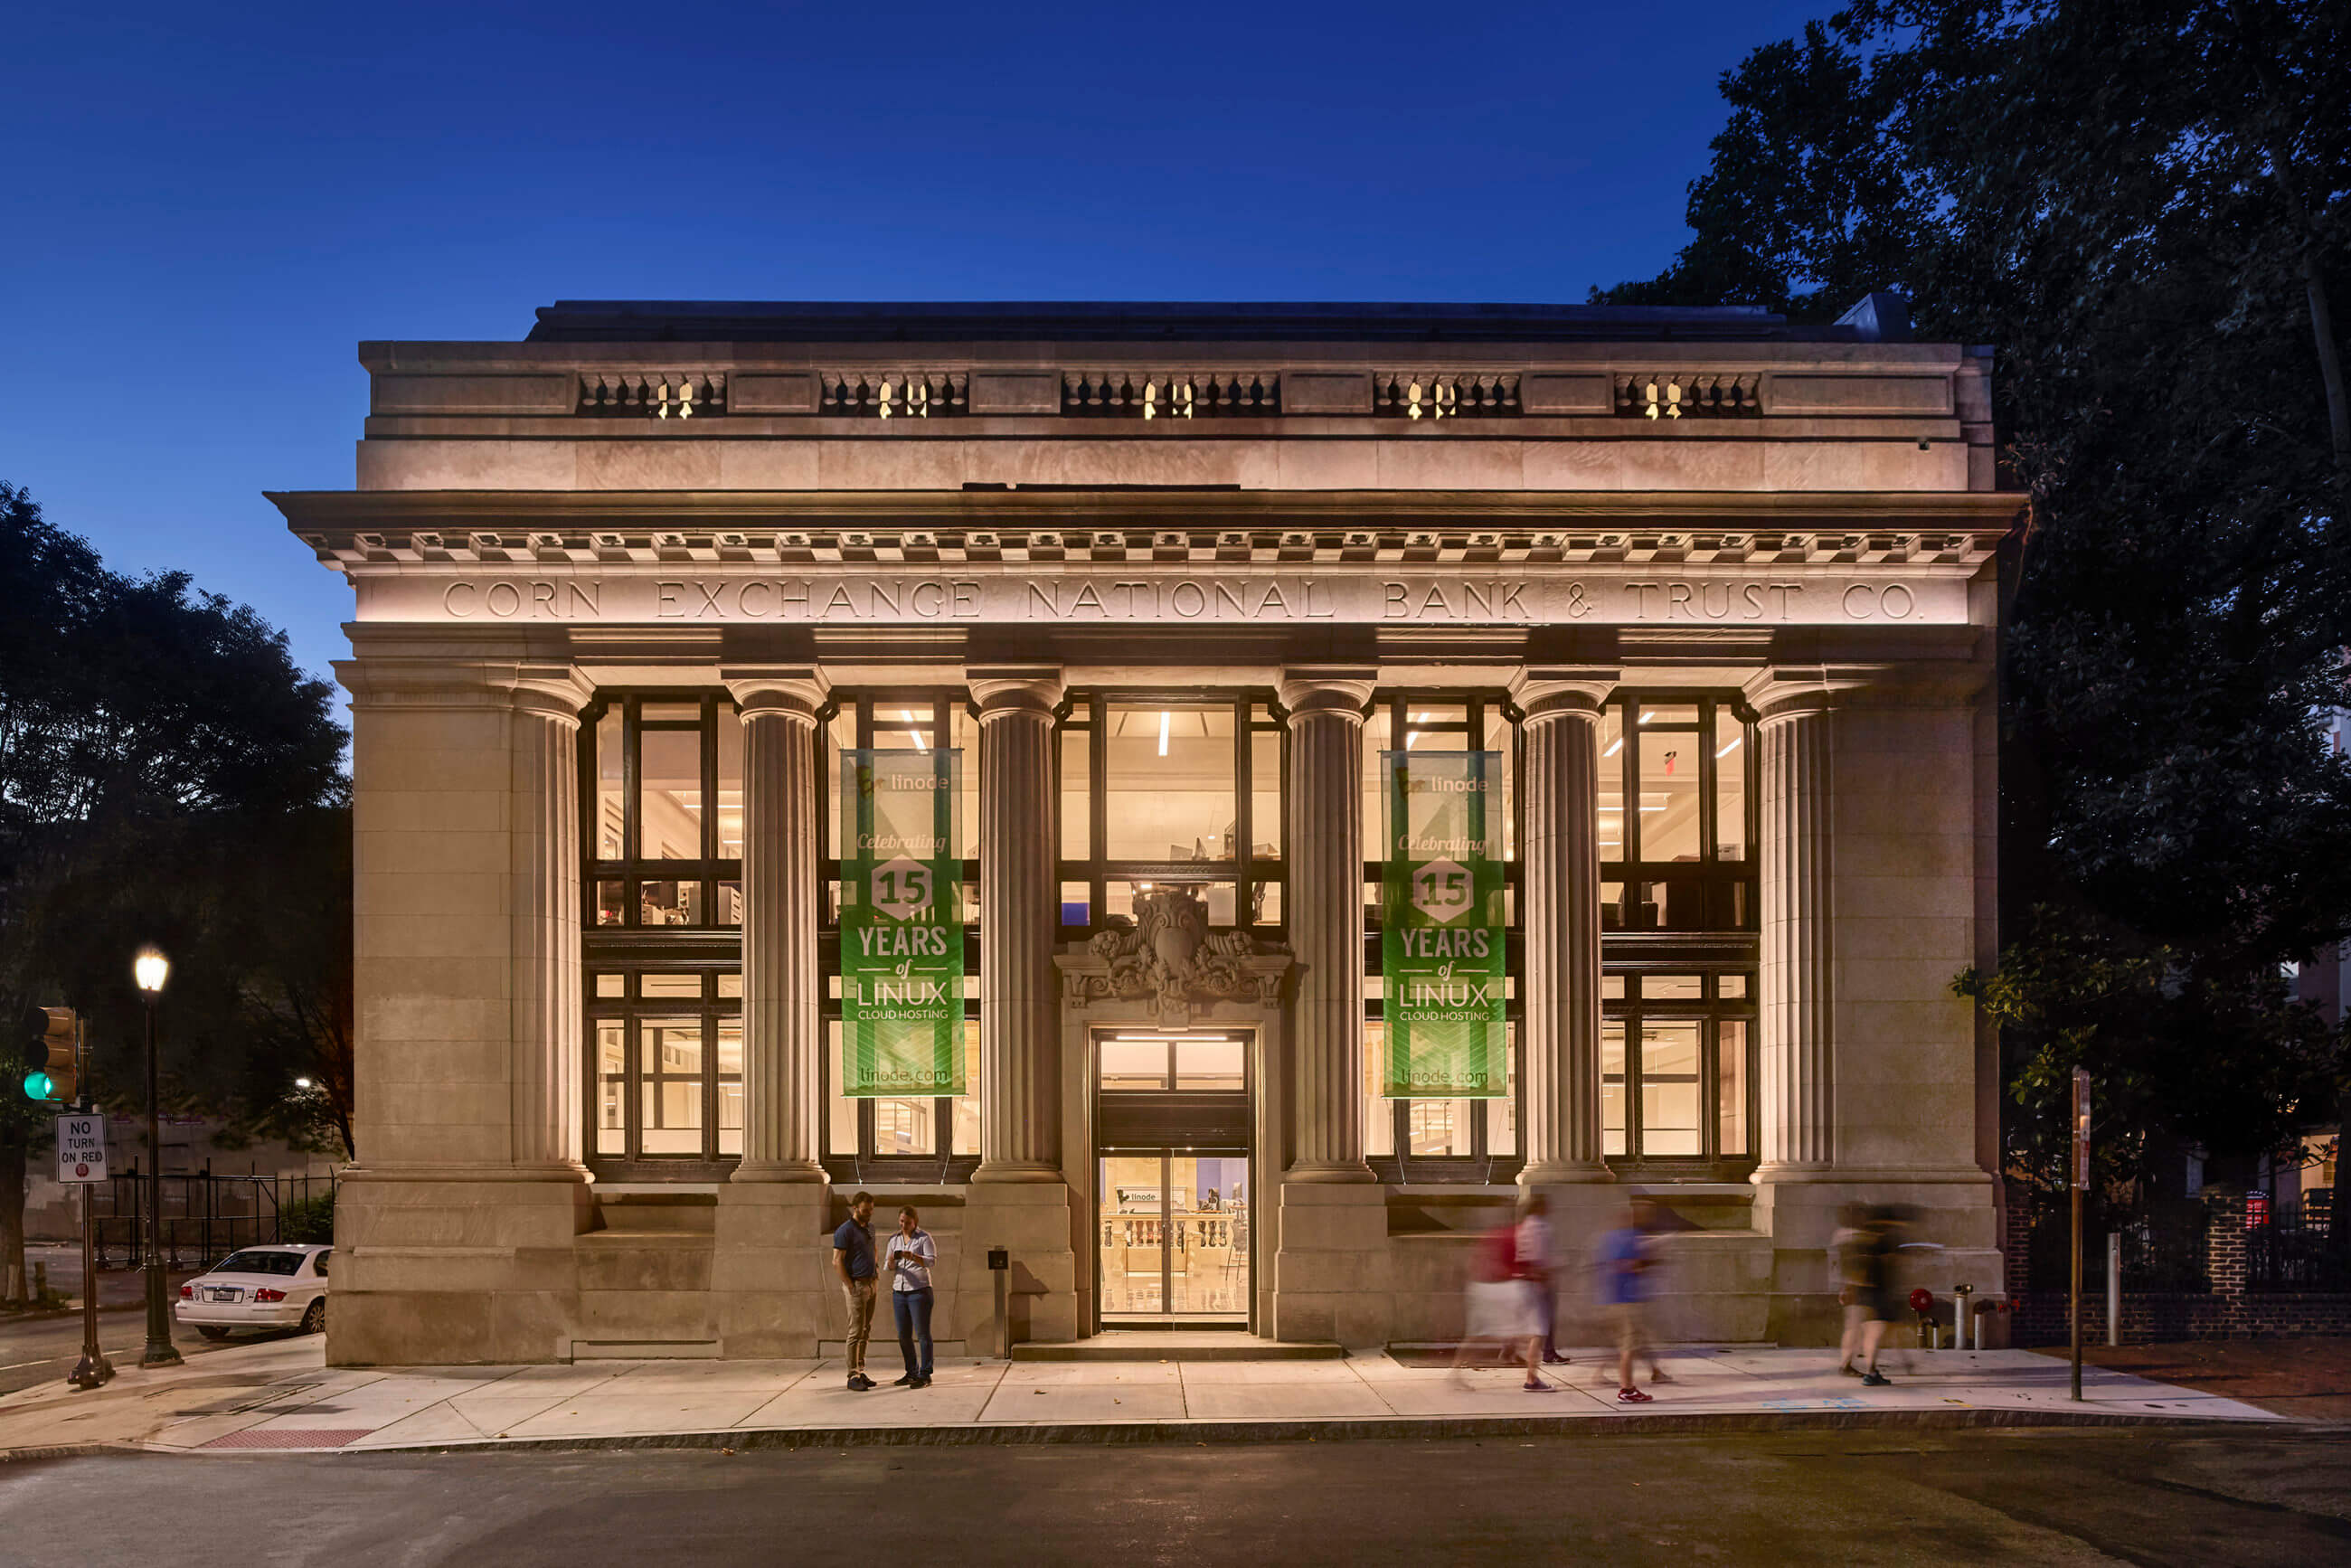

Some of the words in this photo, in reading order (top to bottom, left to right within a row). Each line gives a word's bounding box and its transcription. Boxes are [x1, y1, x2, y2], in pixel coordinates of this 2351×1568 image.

[443, 581, 601, 618] CORN
[654, 581, 983, 618] EXCHANGE
[1025, 581, 1337, 618] NATIONAL
[1380, 581, 1533, 619] BANK
[1567, 582, 1592, 619] &
[1625, 581, 1804, 619] TRUST
[1842, 582, 1925, 619] CO.
[891, 774, 949, 790] linode
[1430, 777, 1489, 792] linode
[856, 833, 947, 854] Celebrating
[1397, 834, 1487, 855] Celebrating
[878, 871, 926, 904] 15
[1420, 873, 1468, 906] 15
[858, 926, 948, 956] YEARS
[1401, 928, 1489, 958] YEARS
[895, 959, 913, 979] of
[1438, 960, 1456, 981] of
[858, 982, 948, 1006] LINUX
[1399, 983, 1489, 1007] LINUX
[858, 1009, 896, 1020] CLOUD
[898, 1009, 949, 1020] HOSTING
[1399, 1011, 1439, 1021] CLOUD
[1440, 1011, 1489, 1021] HOSTING
[860, 1068, 948, 1082] linode.com
[1402, 1070, 1487, 1083] linode.com
[71, 1121, 90, 1134] NO
[68, 1138, 95, 1148] TURN
[61, 1152, 76, 1163] ON
[81, 1151, 103, 1162] RED
